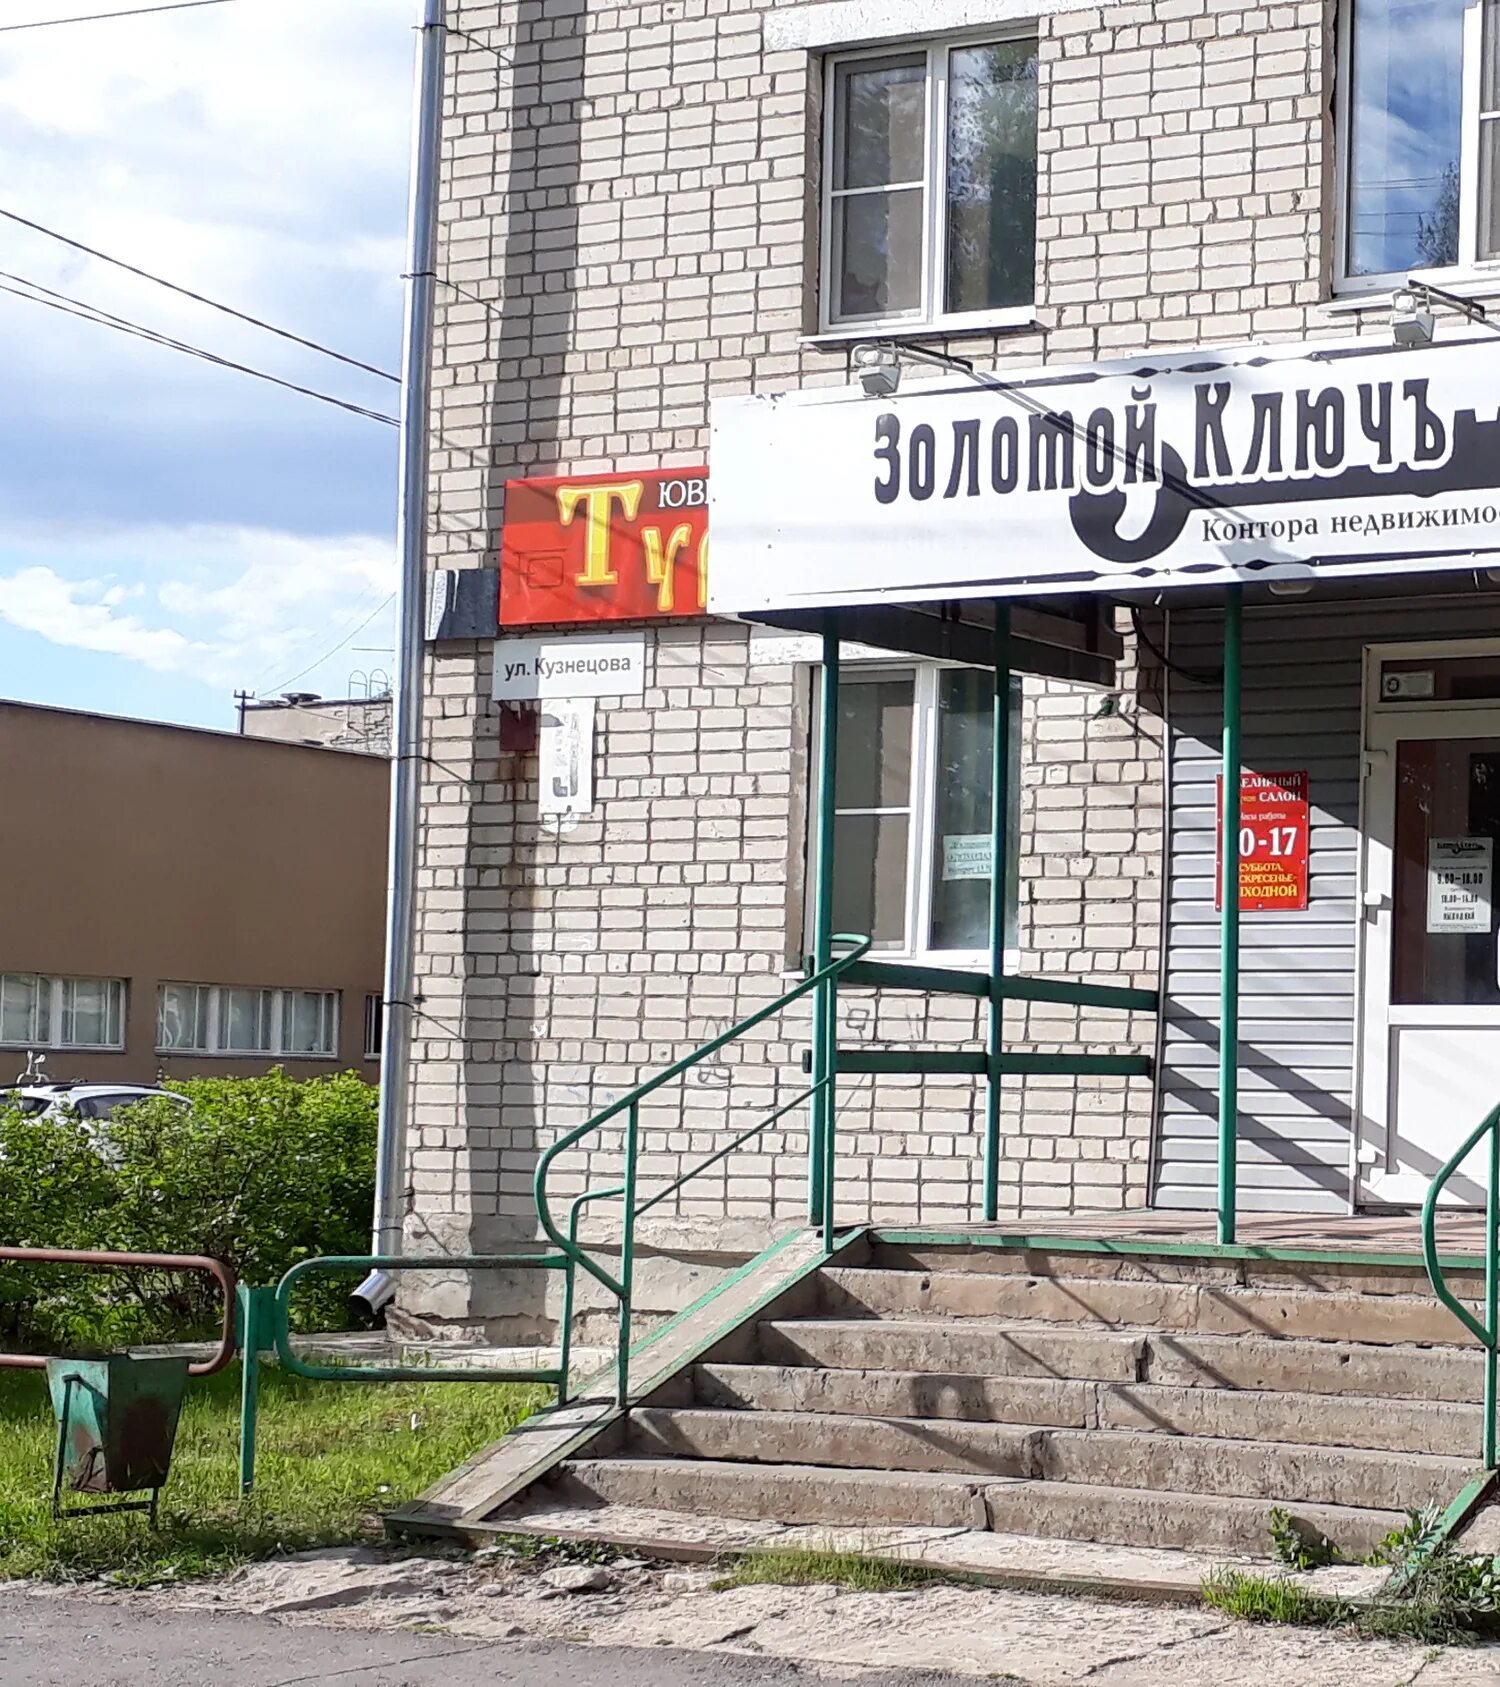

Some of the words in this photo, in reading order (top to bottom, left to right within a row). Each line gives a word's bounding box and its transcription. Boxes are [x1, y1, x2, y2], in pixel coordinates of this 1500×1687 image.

[658, 479, 708, 508] ЮВ
[1202, 515, 1319, 542] Контора
[555, 480, 708, 613] Ту
[504, 662, 531, 682] ул.
[534, 656, 632, 679] Кузнецова
[1259, 792, 1301, 802] САЛОН
[1239, 827, 1297, 857] 0-17
